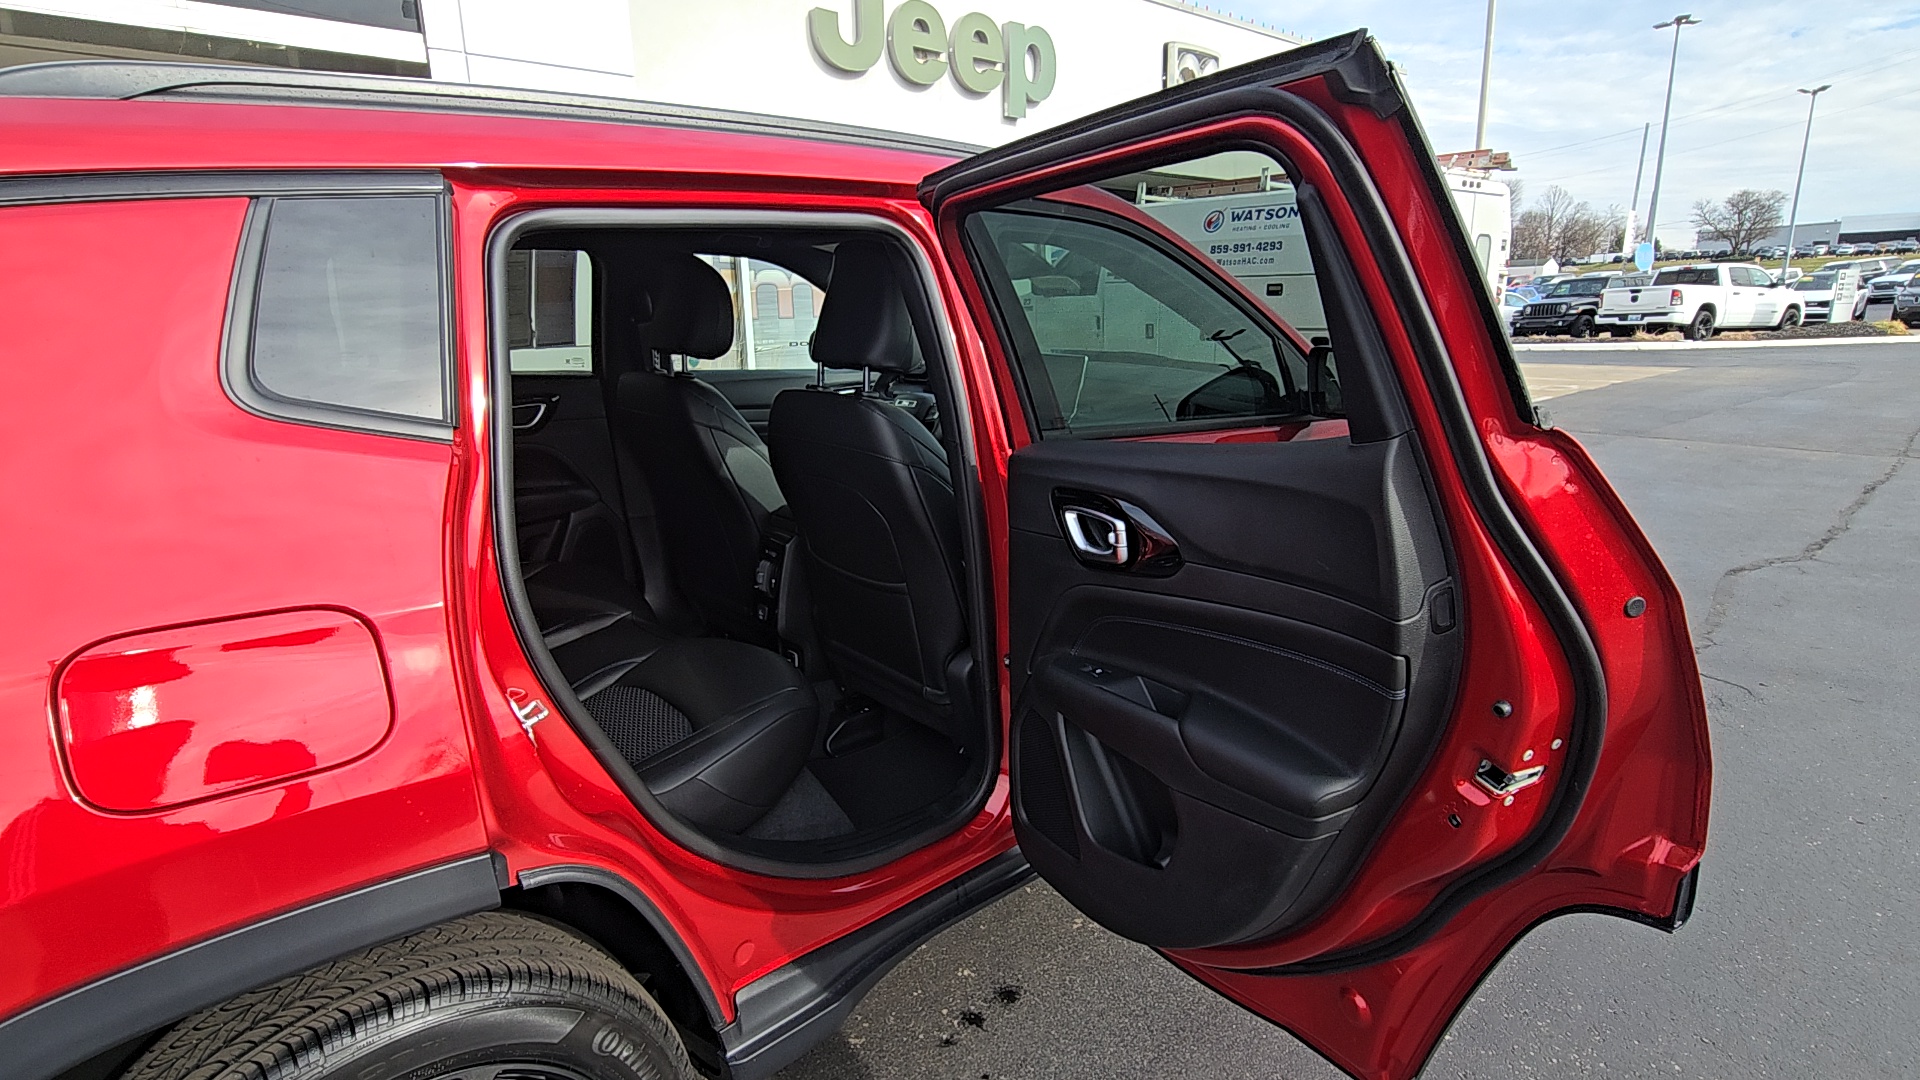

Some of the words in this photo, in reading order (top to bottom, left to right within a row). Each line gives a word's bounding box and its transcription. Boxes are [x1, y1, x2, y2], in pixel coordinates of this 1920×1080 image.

[808, 0, 1056, 119] Jeep
[1231, 206, 1299, 223] WATSON
[1232, 224, 1257, 232] HEATING
[1263, 223, 1291, 231] COOLING
